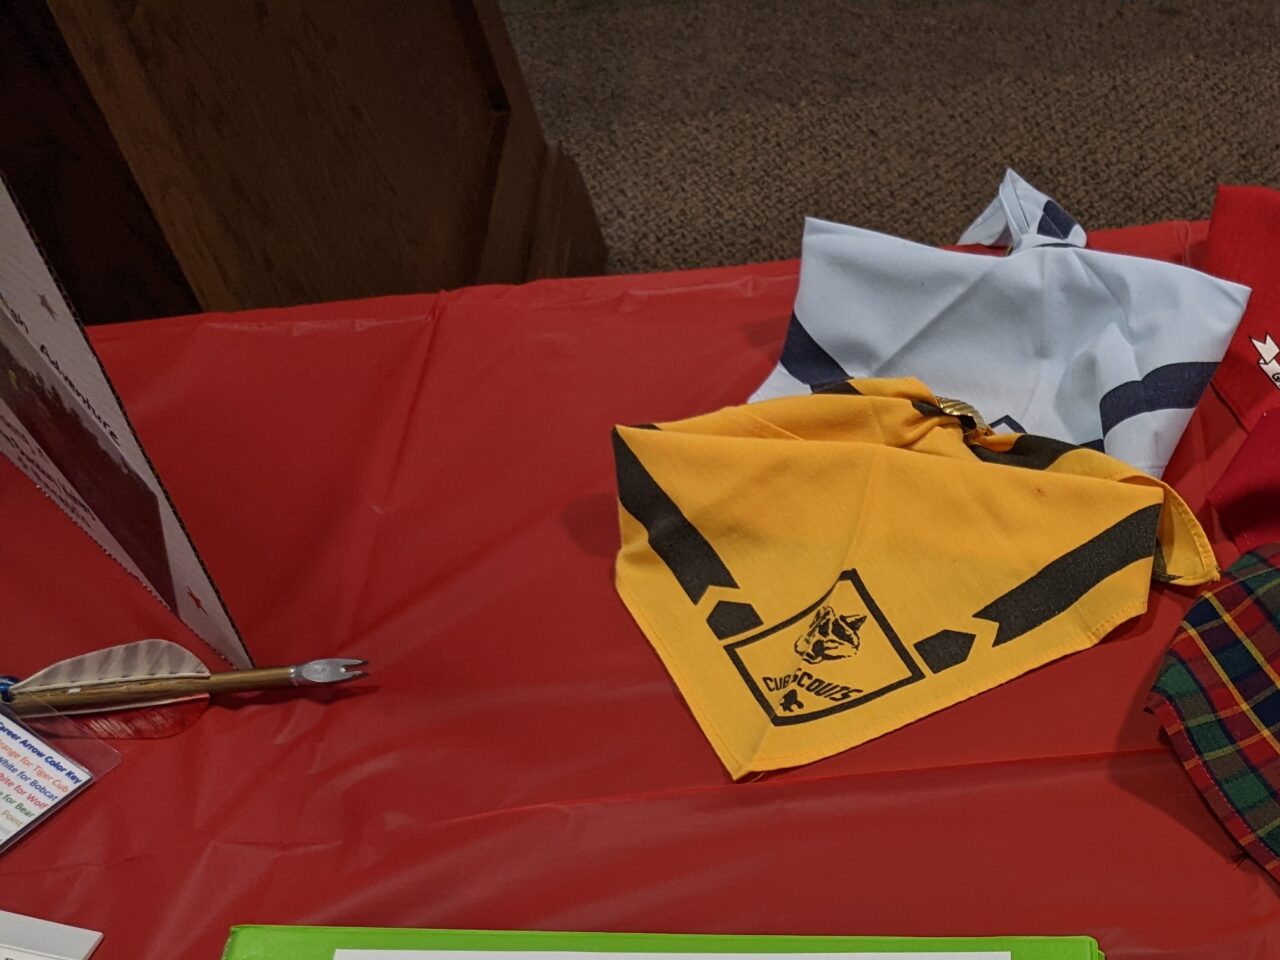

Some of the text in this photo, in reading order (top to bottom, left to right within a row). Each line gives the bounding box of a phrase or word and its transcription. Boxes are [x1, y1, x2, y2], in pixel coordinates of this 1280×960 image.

[762, 668, 864, 702] CUB SCOUTS
[20, 739, 46, 758] Arrow
[45, 755, 67, 773] Color
[65, 770, 82, 785] Key
[20, 755, 34, 767] for
[33, 763, 53, 781] Tiger
[52, 778, 69, 793] Cub
[14, 784, 28, 796] for
[27, 793, 49, 810] Wolf
[17, 770, 31, 782] for
[29, 779, 58, 802] Bobcat
[2, 793, 16, 805] for
[15, 802, 36, 818] Bear
